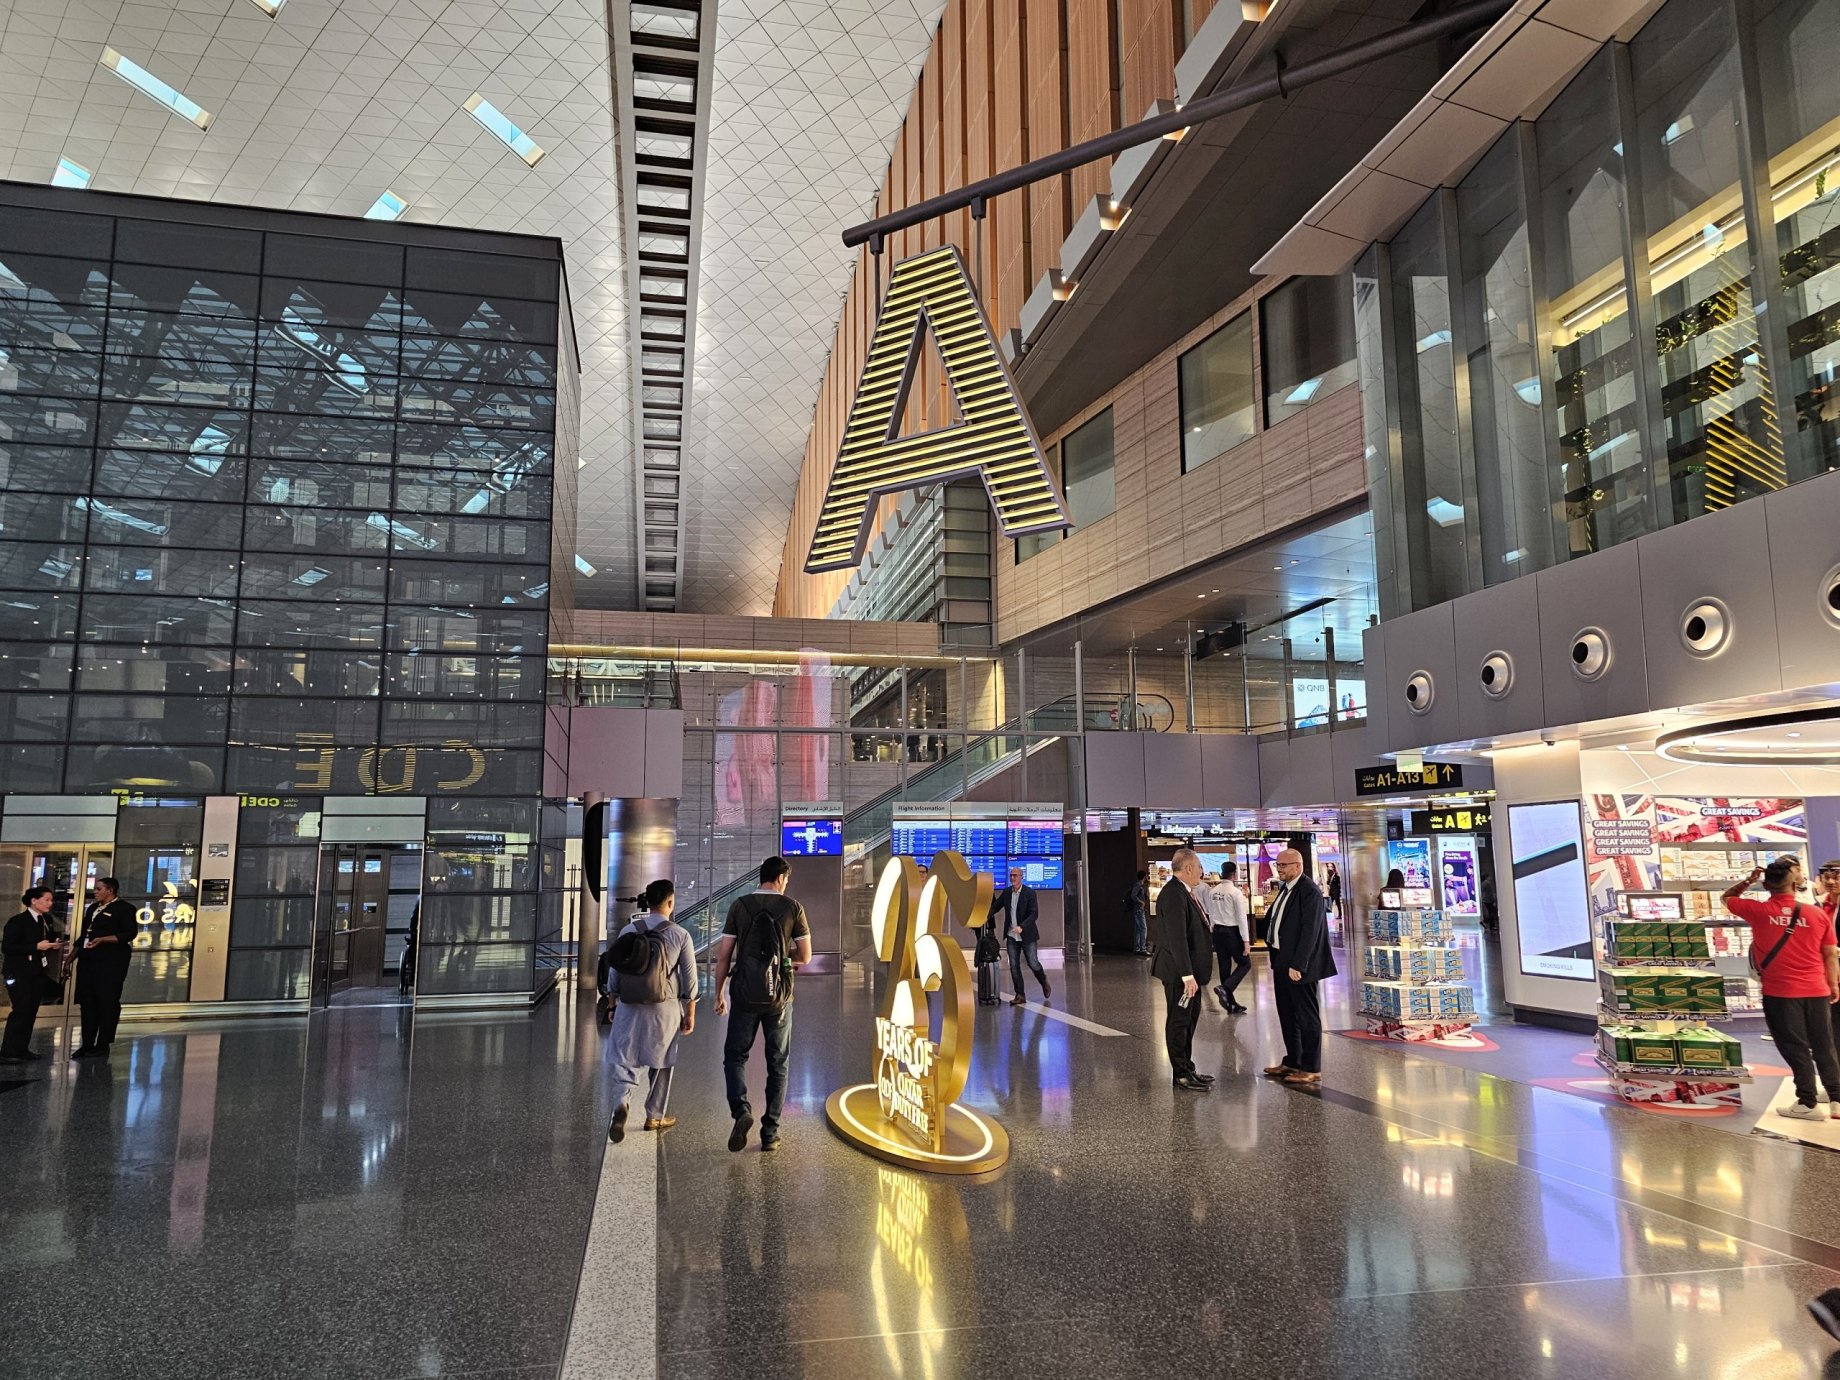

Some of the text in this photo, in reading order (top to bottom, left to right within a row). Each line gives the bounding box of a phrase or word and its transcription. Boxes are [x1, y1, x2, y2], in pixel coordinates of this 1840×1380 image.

[803, 243, 1076, 575] A
[1306, 684, 1326, 692] QNB
[1376, 772, 1420, 787] A1-A13
[1701, 808, 1761, 816] GREAT SAVINGS
[1445, 815, 1455, 829] A
[1593, 820, 1648, 828] GREAT SAVINGS
[1594, 829, 1649, 837] GREAT SAVINGS
[1595, 838, 1650, 846] GREAT SAVINGS
[1596, 847, 1651, 855] GREAT SAVINGS
[875, 1016, 934, 1077] YEARS OF
[897, 1072, 924, 1109] QATAR
